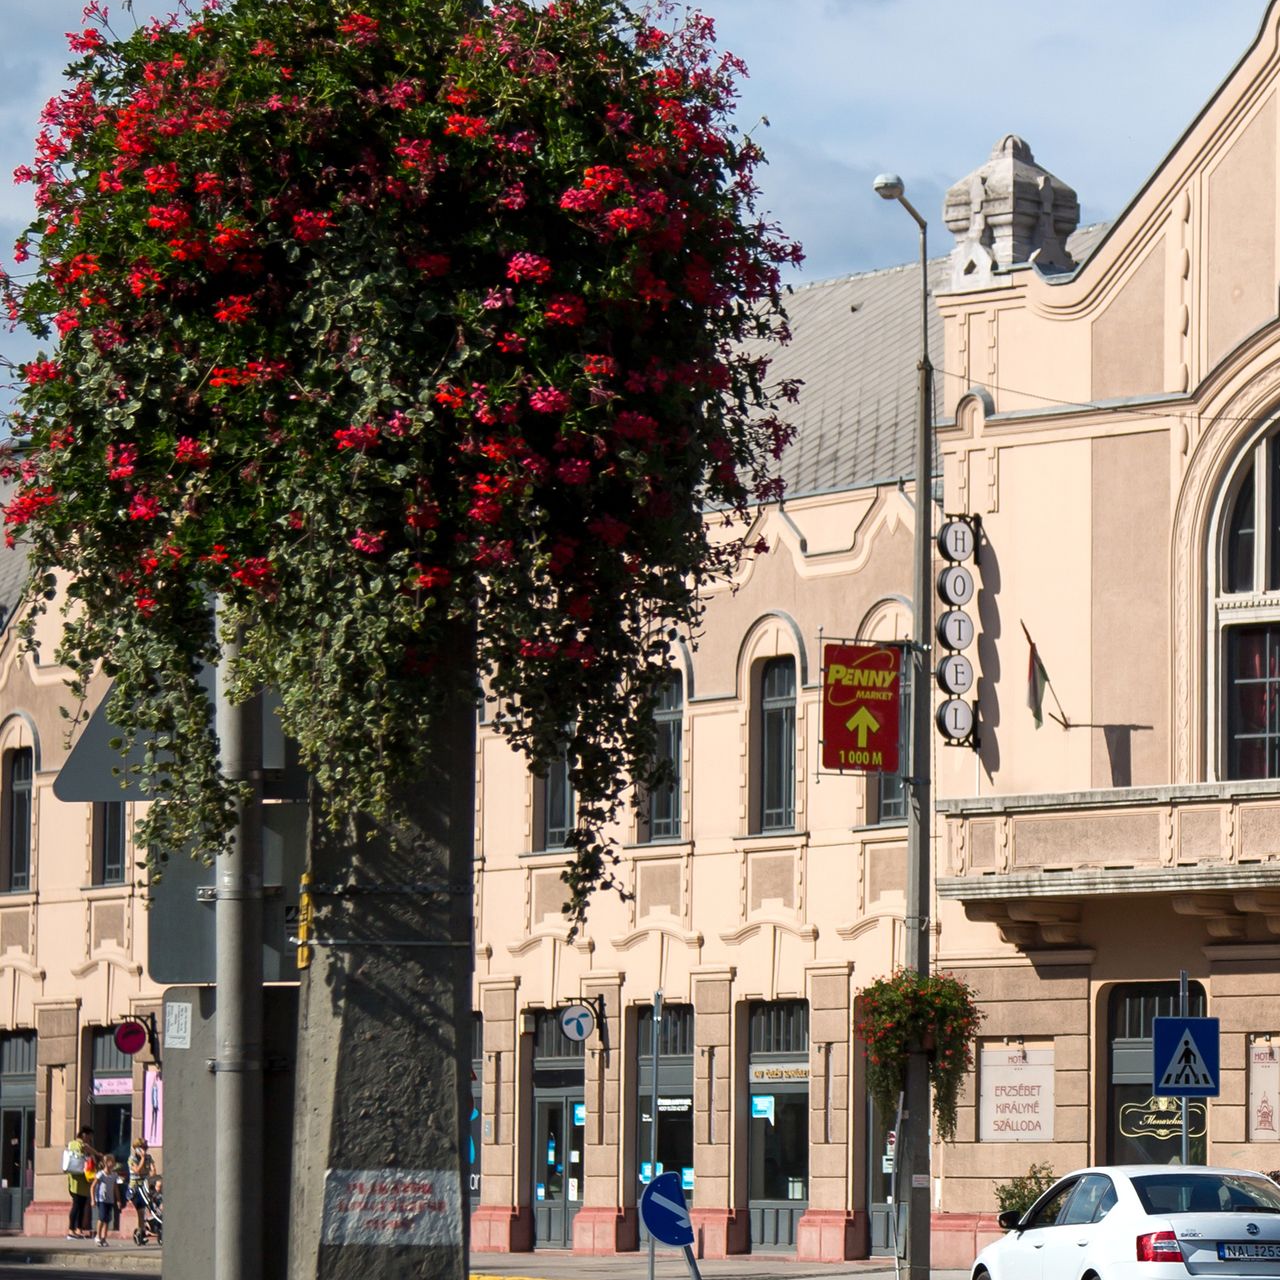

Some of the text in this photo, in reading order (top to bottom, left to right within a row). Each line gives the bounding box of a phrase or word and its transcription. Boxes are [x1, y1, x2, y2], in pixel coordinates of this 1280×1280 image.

[953, 530, 966, 731] HOTEL
[827, 664, 897, 688] PENNY
[856, 690, 894, 701] MARKET
[839, 750, 882, 765] 1 000 M
[994, 1083, 1042, 1097] ERZSÉBET
[995, 1100, 1040, 1114] KIRÁLYNÉ
[993, 1118, 1042, 1131] SZÁLLODA
